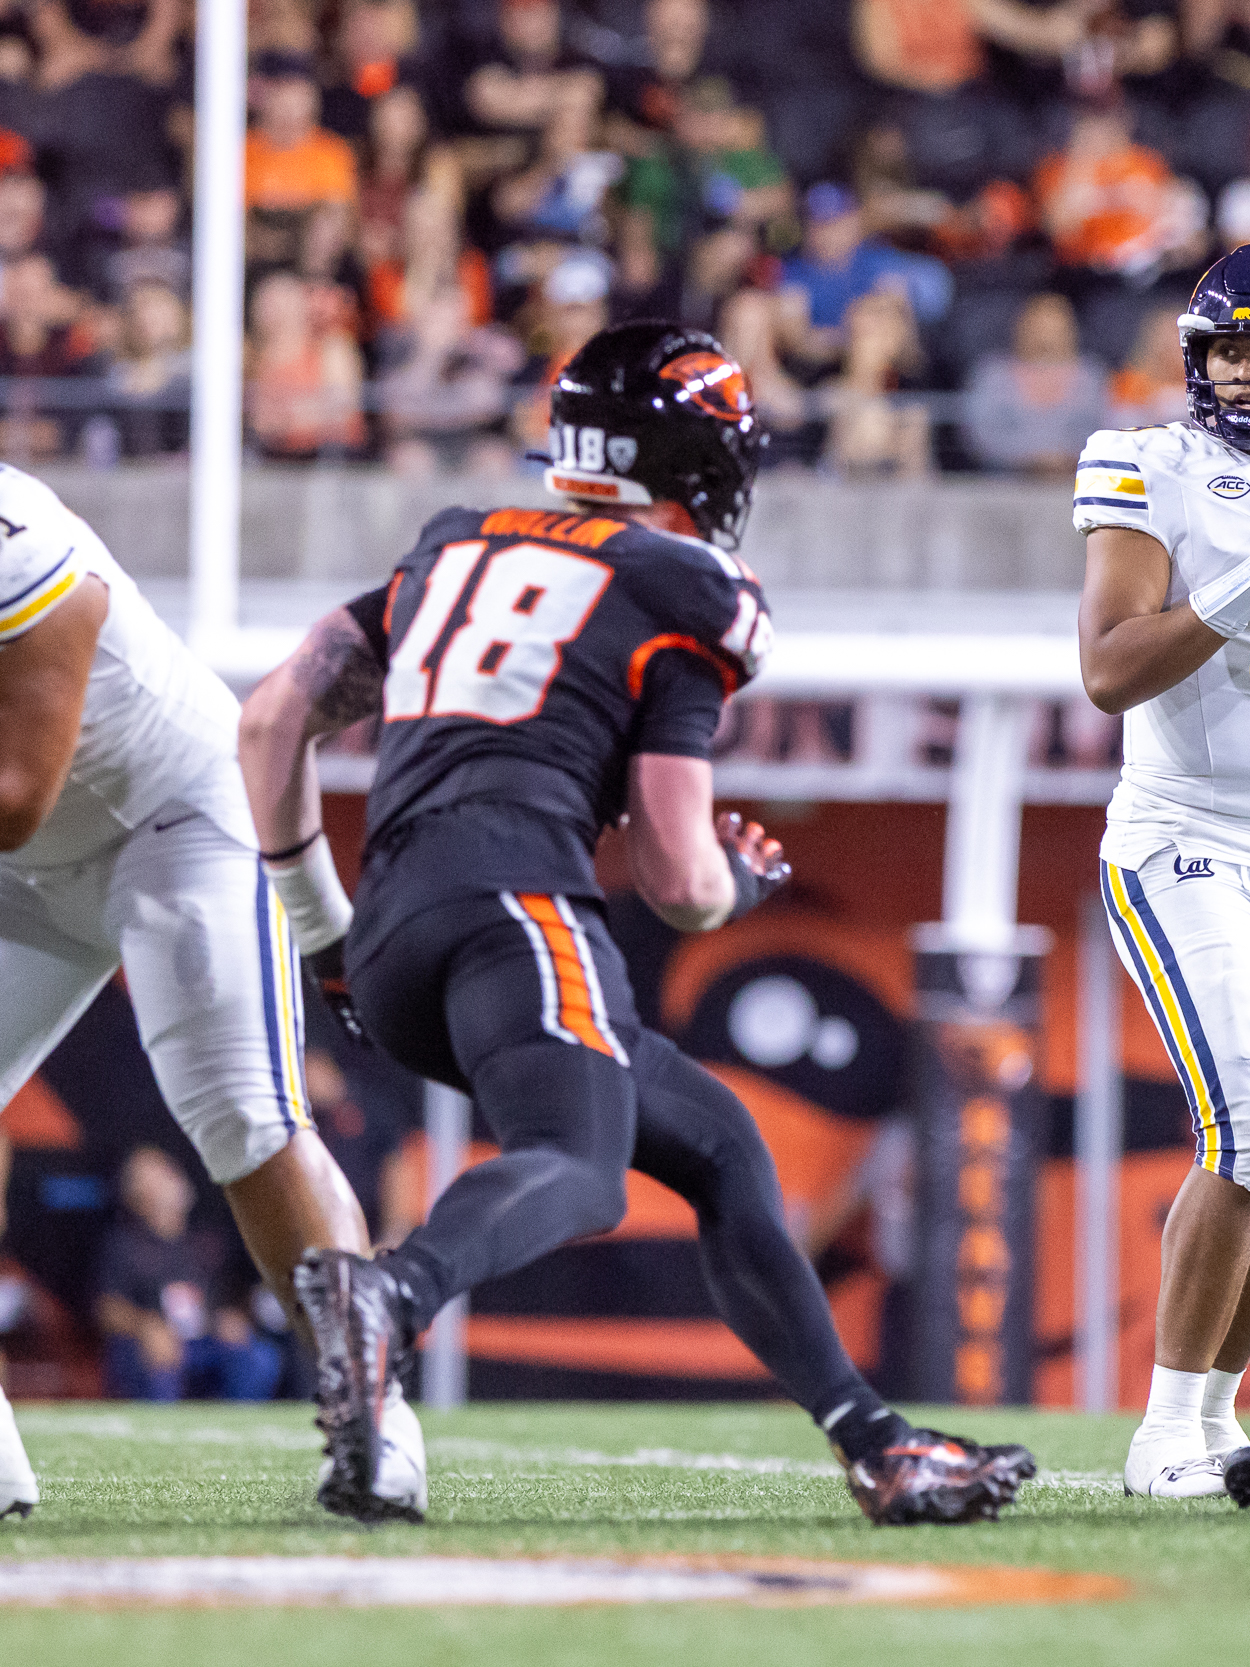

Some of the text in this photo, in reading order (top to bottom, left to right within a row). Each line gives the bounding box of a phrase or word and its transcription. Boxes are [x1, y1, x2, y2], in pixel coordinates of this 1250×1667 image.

[561, 424, 606, 471] 18
[1215, 480, 1246, 490] ACC
[383, 540, 615, 726] 18
[1173, 854, 1216, 884] Cal
